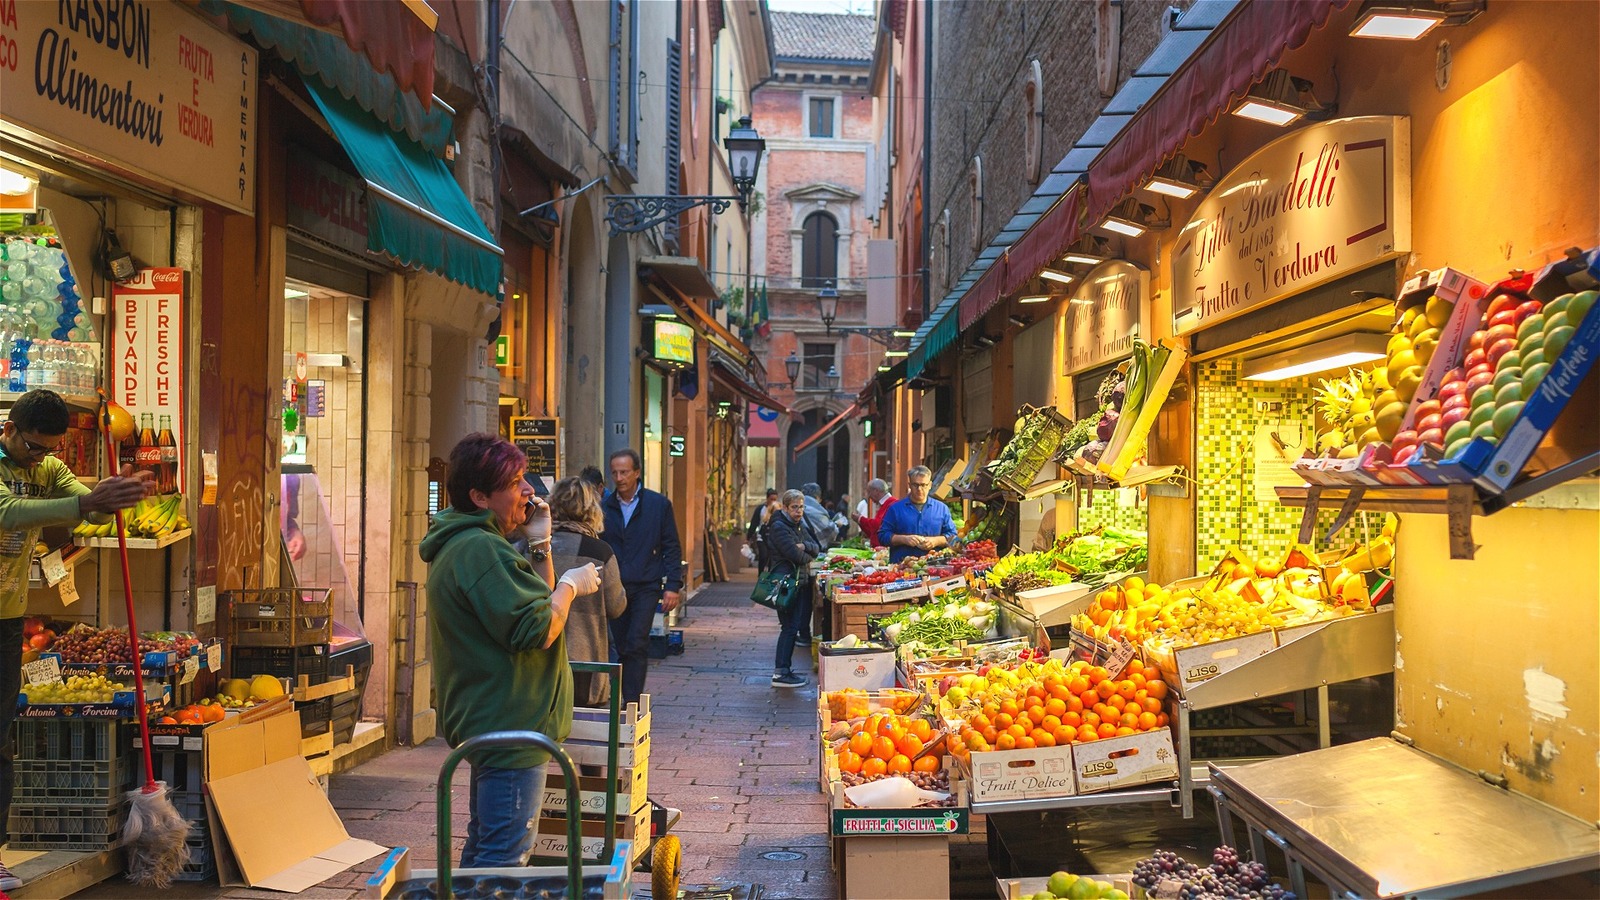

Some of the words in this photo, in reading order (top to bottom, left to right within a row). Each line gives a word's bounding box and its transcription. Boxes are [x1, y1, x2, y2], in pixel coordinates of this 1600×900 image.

[0, 34, 18, 72] CO
[179, 35, 214, 84] FRUTTA
[35, 28, 164, 147] Alimentari
[192, 78, 199, 107] E
[178, 102, 214, 148] VERDURA
[239, 52, 248, 200] ALIMENTARI
[1239, 142, 1340, 233] Bardelli
[1239, 233, 1252, 260] dal
[1255, 226, 1274, 252] 1863
[1195, 281, 1239, 320] Frutta
[1244, 282, 1252, 300] e
[1254, 242, 1339, 293] Verdura
[125, 300, 137, 406] BEVANDE
[156, 300, 169, 406] FRESCHE
[1541, 345, 1588, 403] Marlene
[61, 665, 90, 676] Atonio
[115, 665, 150, 676] Forcna
[1188, 664, 1218, 678] LISO
[20, 706, 56, 717] Antonio
[82, 705, 118, 716] Forcina
[1084, 760, 1114, 773] LISO
[544, 791, 588, 807] Trane
[981, 779, 1016, 791] Fruit
[846, 819, 880, 830] FRUTTI
[885, 819, 894, 830] di
[898, 819, 936, 830] SICILIA
[541, 838, 591, 851] Trase
